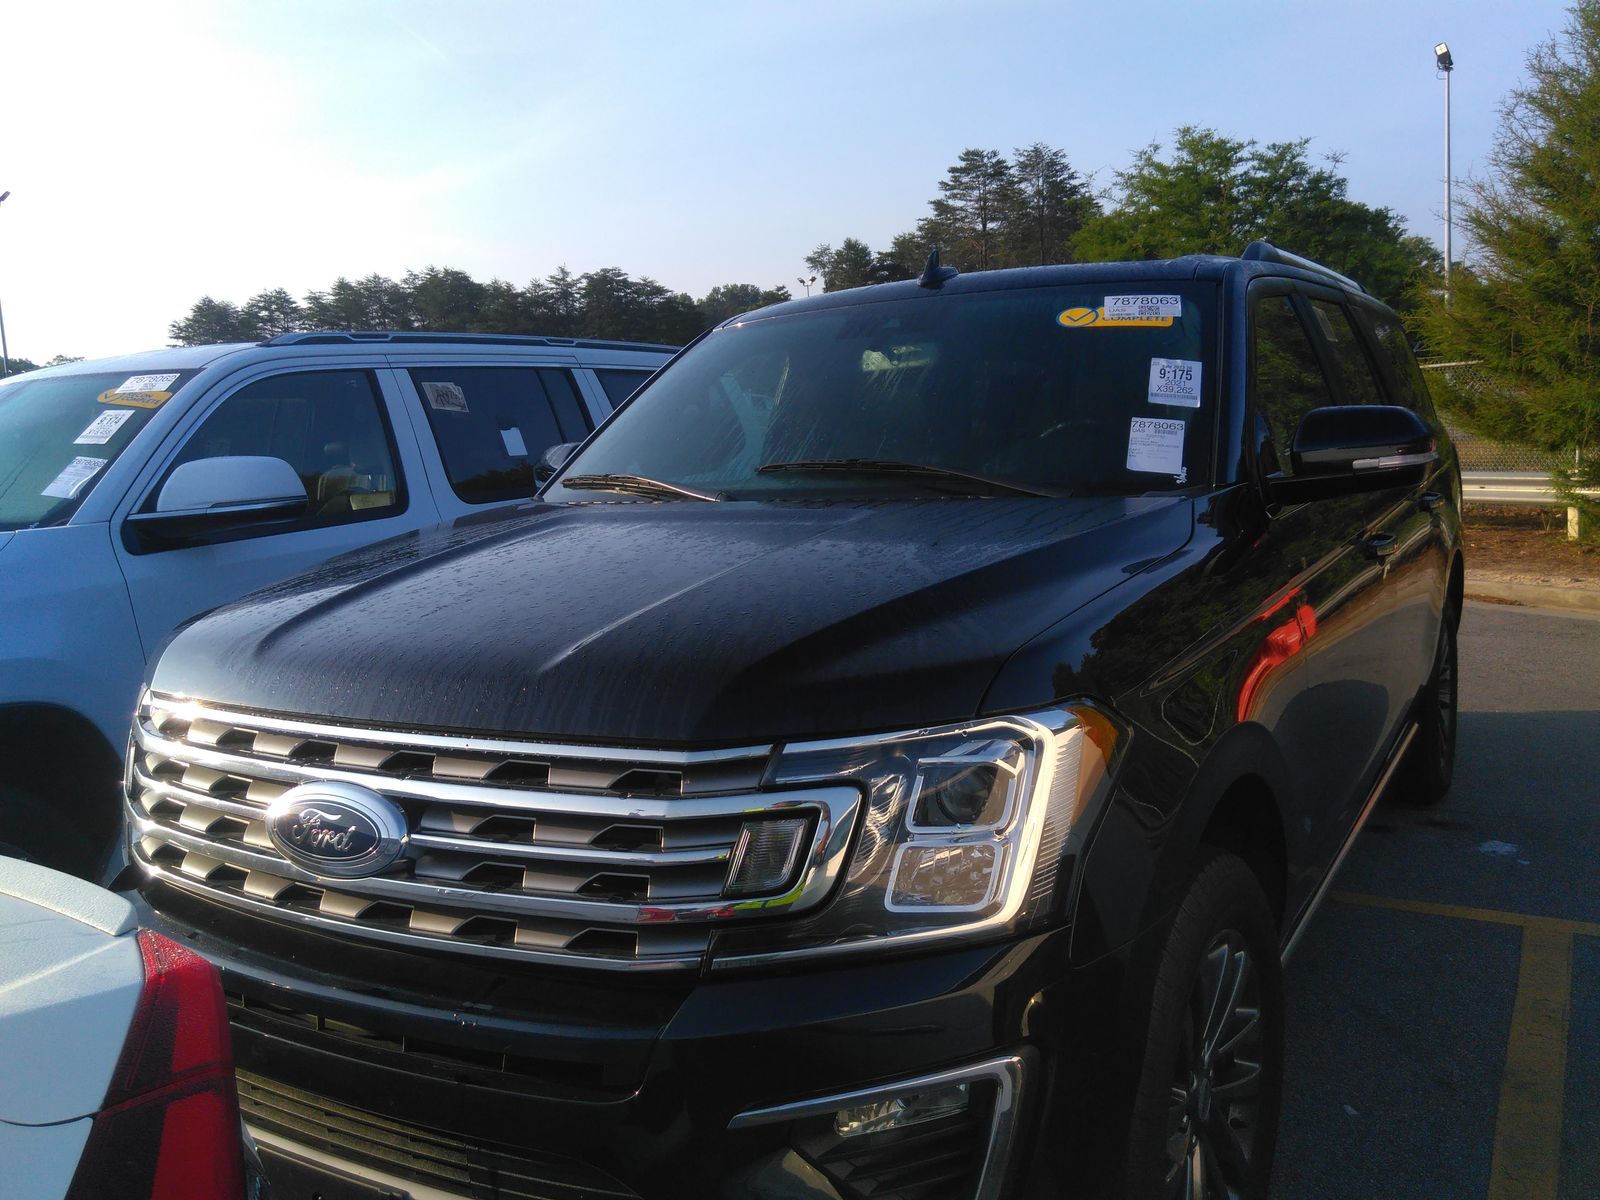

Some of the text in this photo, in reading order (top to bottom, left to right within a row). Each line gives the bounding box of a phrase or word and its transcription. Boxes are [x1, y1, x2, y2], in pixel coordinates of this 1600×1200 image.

[1111, 296, 1179, 305] 7878063
[1159, 367, 1193, 381] 9:175
[1131, 420, 1184, 431] 7878063
[291, 808, 357, 852] Ford
